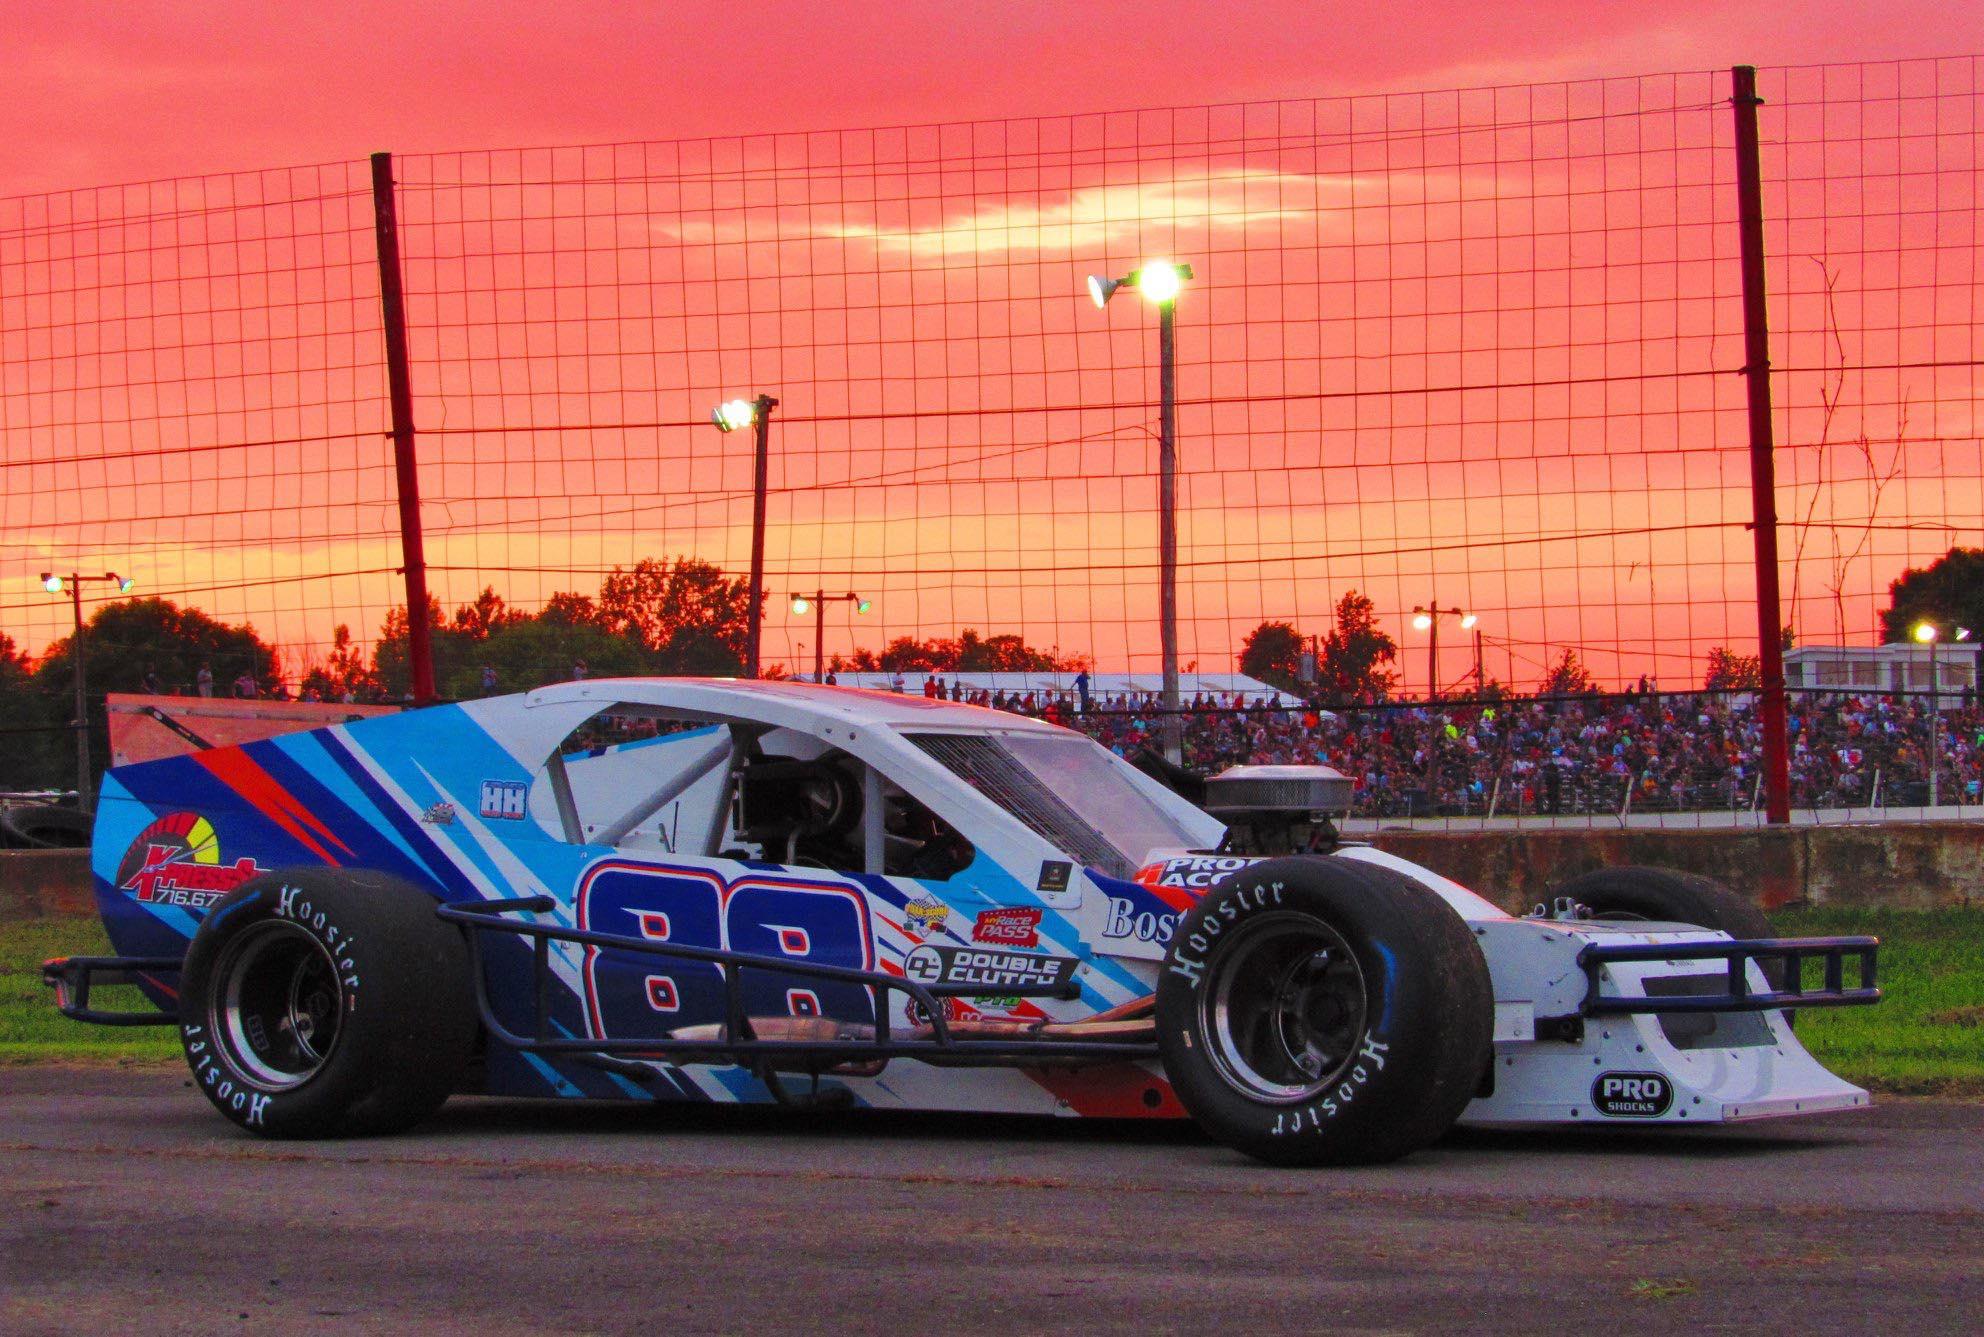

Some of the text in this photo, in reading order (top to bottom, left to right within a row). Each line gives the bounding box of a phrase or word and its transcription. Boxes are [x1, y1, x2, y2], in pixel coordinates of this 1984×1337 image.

[156, 889, 225, 907] 716.67
[273, 884, 360, 988] Hoosier
[576, 858, 880, 1052] 88
[953, 951, 1062, 975] DOUBLE
[979, 924, 1032, 939] PASS
[1169, 880, 1285, 989] Hoosier
[186, 1024, 273, 1126] Hoosier
[1270, 1028, 1390, 1135] Hoosier
[1603, 1079, 1661, 1100] PRO
[1607, 1102, 1655, 1112] SHOCKS
